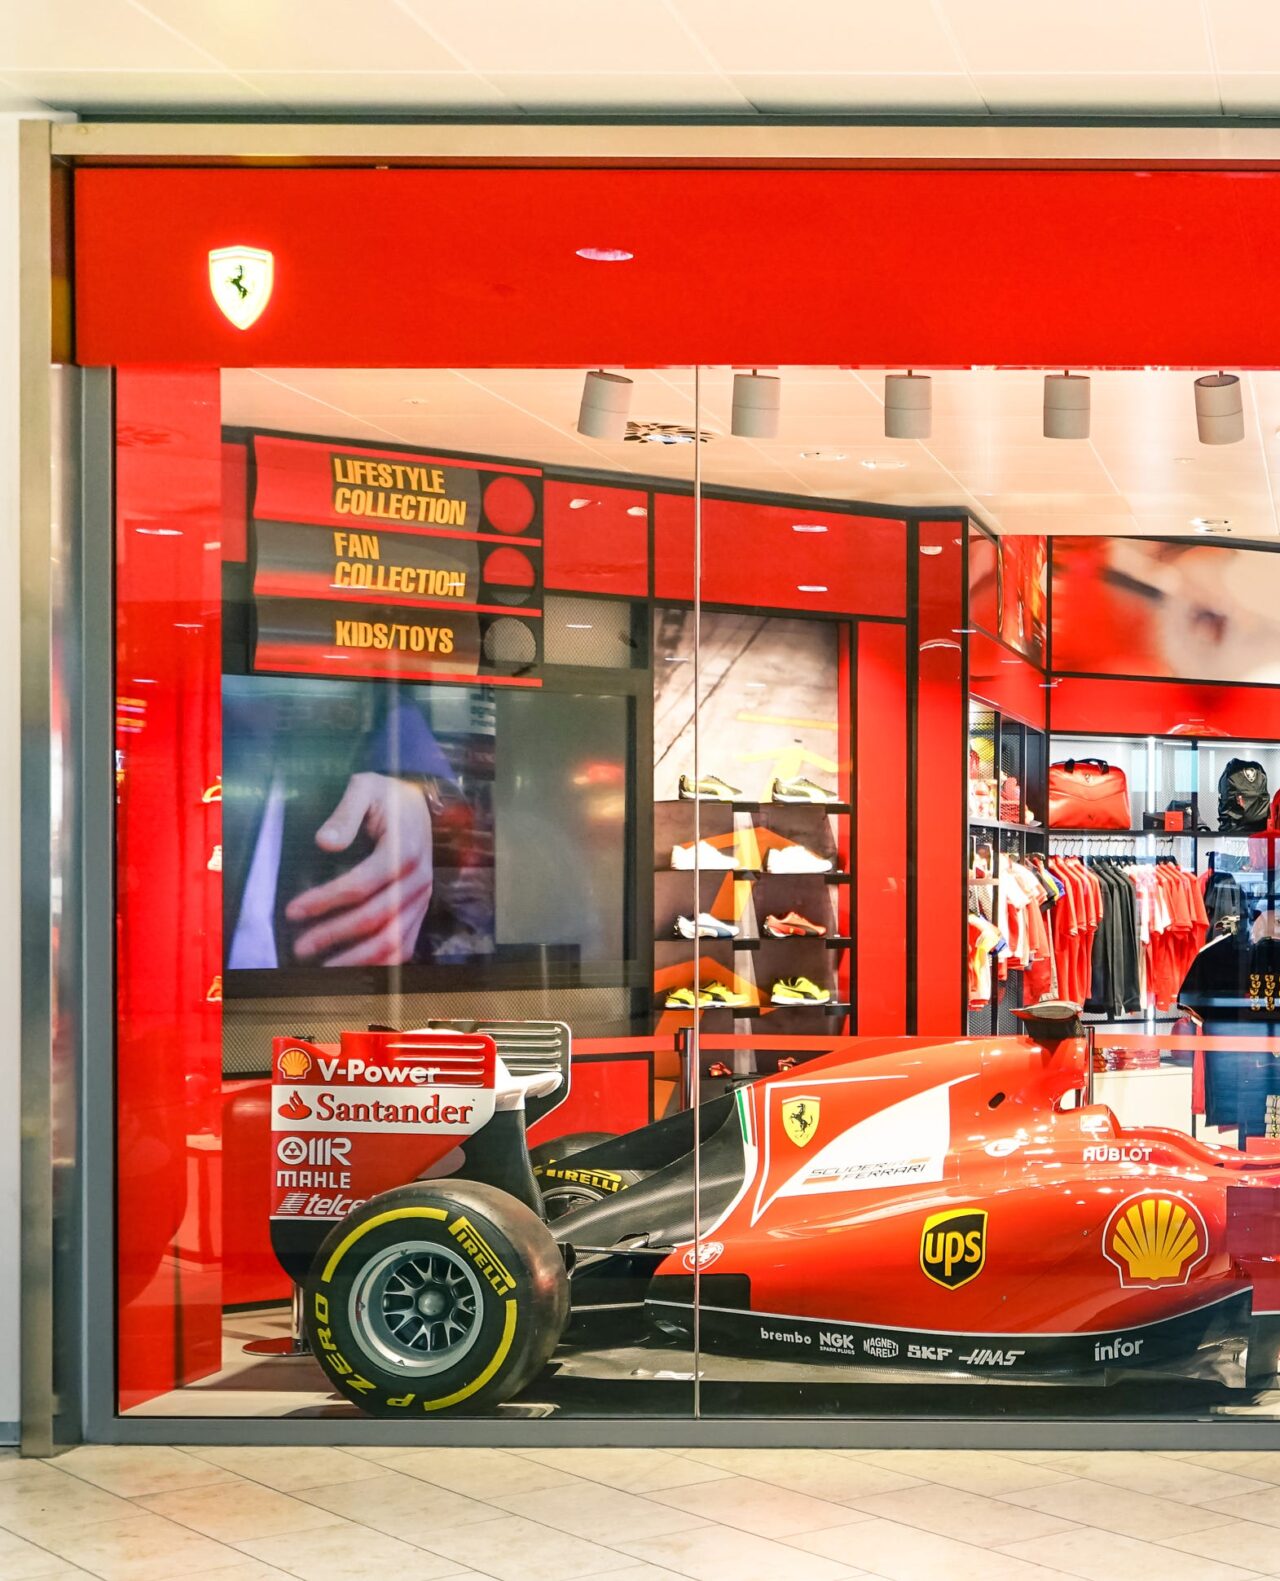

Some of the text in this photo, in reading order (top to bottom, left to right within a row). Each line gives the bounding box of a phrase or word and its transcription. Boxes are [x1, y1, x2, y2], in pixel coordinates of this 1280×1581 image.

[334, 458, 446, 494] LIFESTYLE
[335, 487, 467, 526] COLLECTION
[333, 532, 380, 560] FAN
[335, 562, 467, 597] COLLECTION
[335, 620, 454, 654] KIDS/TOYS
[317, 1058, 442, 1084] V-Power
[316, 1093, 474, 1124] Santander
[1083, 1144, 1153, 1162] HUBLOT
[276, 1170, 351, 1189] MAHLE
[842, 1164, 926, 1181] FERRARI
[448, 1215, 517, 1297] PIRELLI
[925, 1231, 982, 1276] ups
[760, 1327, 812, 1345] brembo
[819, 1332, 854, 1349] NGK
[1094, 1337, 1144, 1361] infor
[315, 1292, 416, 1407] P ZERO
[820, 1345, 855, 1356] SPARK PLUGS
[907, 1344, 953, 1360] SKF
[958, 1349, 1026, 1366] HAAS
